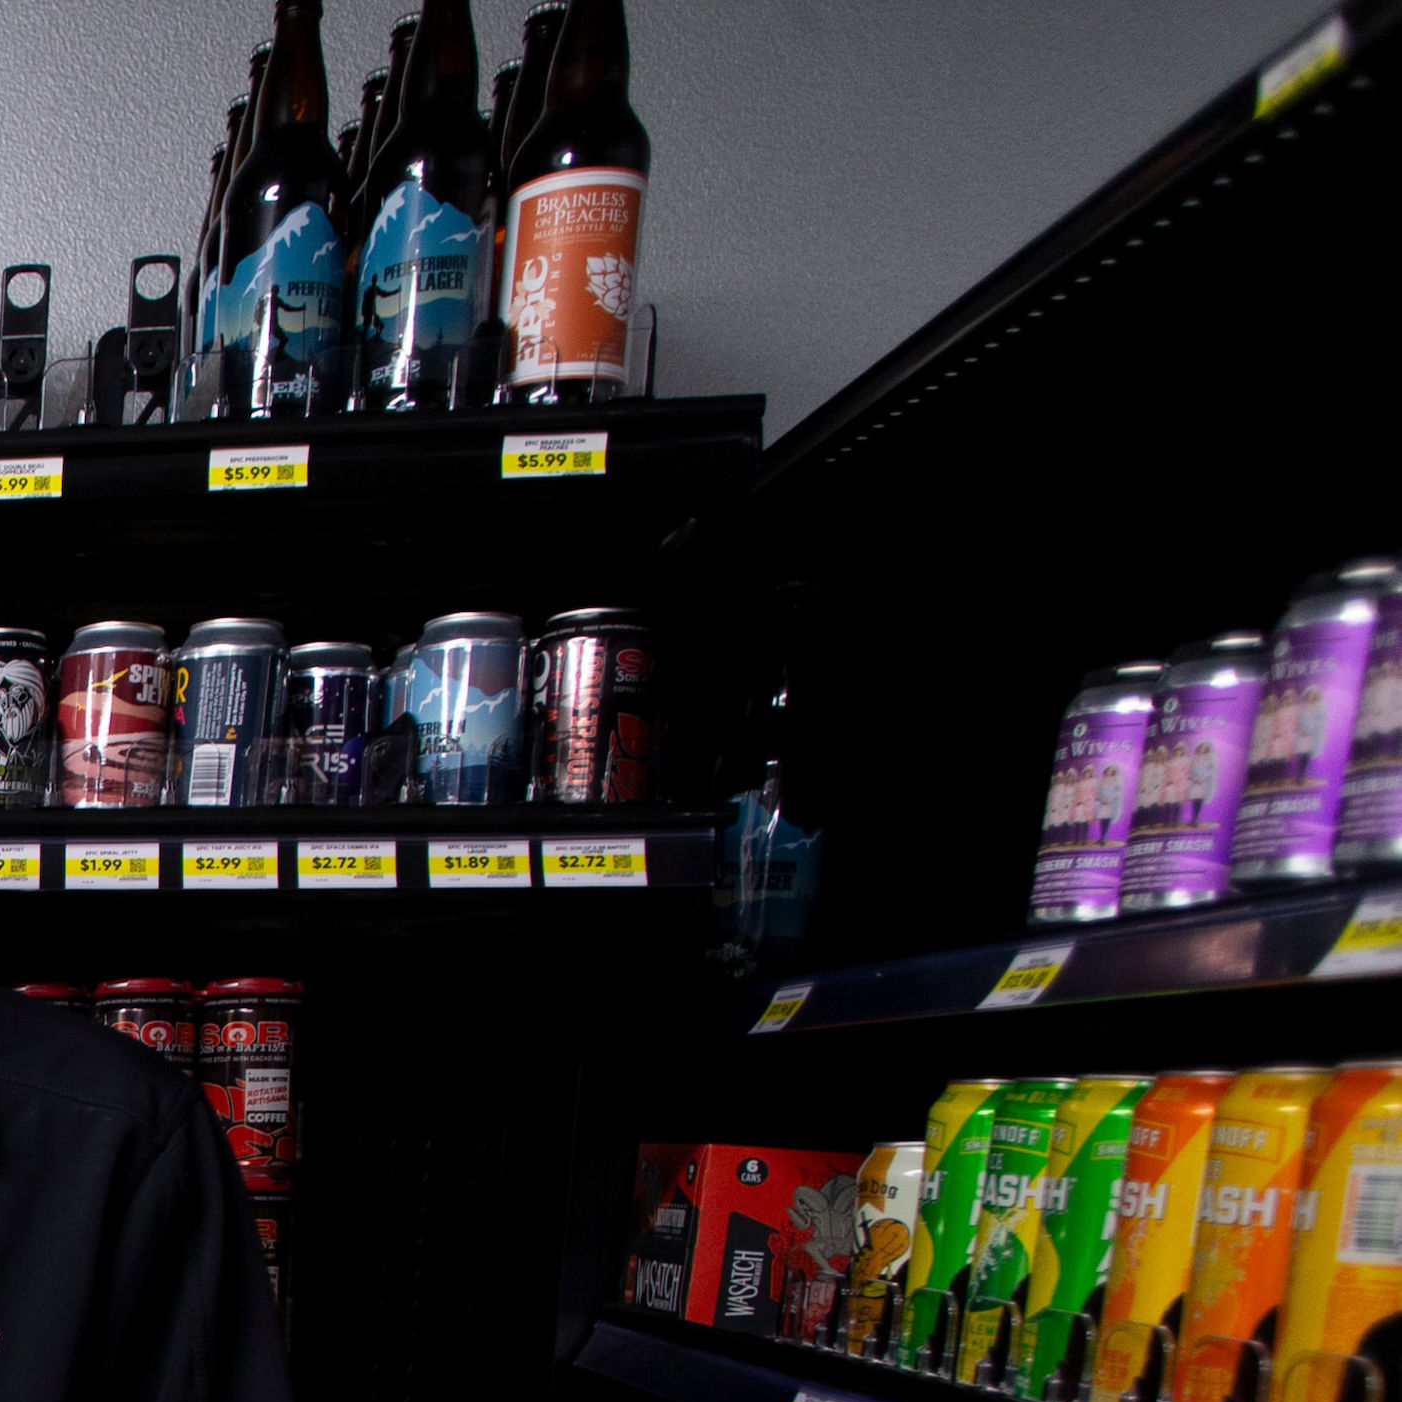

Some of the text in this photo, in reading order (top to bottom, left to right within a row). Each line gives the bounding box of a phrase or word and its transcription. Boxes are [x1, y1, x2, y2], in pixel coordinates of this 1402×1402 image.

[536, 191, 627, 216] BRAINLESS
[534, 205, 629, 228] ON PEACHES
[610, 222, 624, 234] ALE
[417, 272, 464, 292] LAGER
[517, 452, 567, 468] $5.99
[225, 465, 271, 480] $5.99
[80, 859, 122, 873] $1.99
[196, 857, 242, 870] $2.99
[312, 856, 357, 870] $2.72
[445, 856, 490, 870] $1.89
[559, 855, 606, 869] $2.72
[200, 1021, 289, 1047] SOB
[235, 1042, 288, 1052] BAPTIST
[247, 1086, 288, 1099] ROTATING
[247, 1112, 287, 1124] COFFEE
[747, 1159, 758, 1173] 6
[740, 1171, 762, 1184] CANS
[636, 1258, 683, 1313] WASATCH
[725, 1250, 764, 1317] WASATCH
